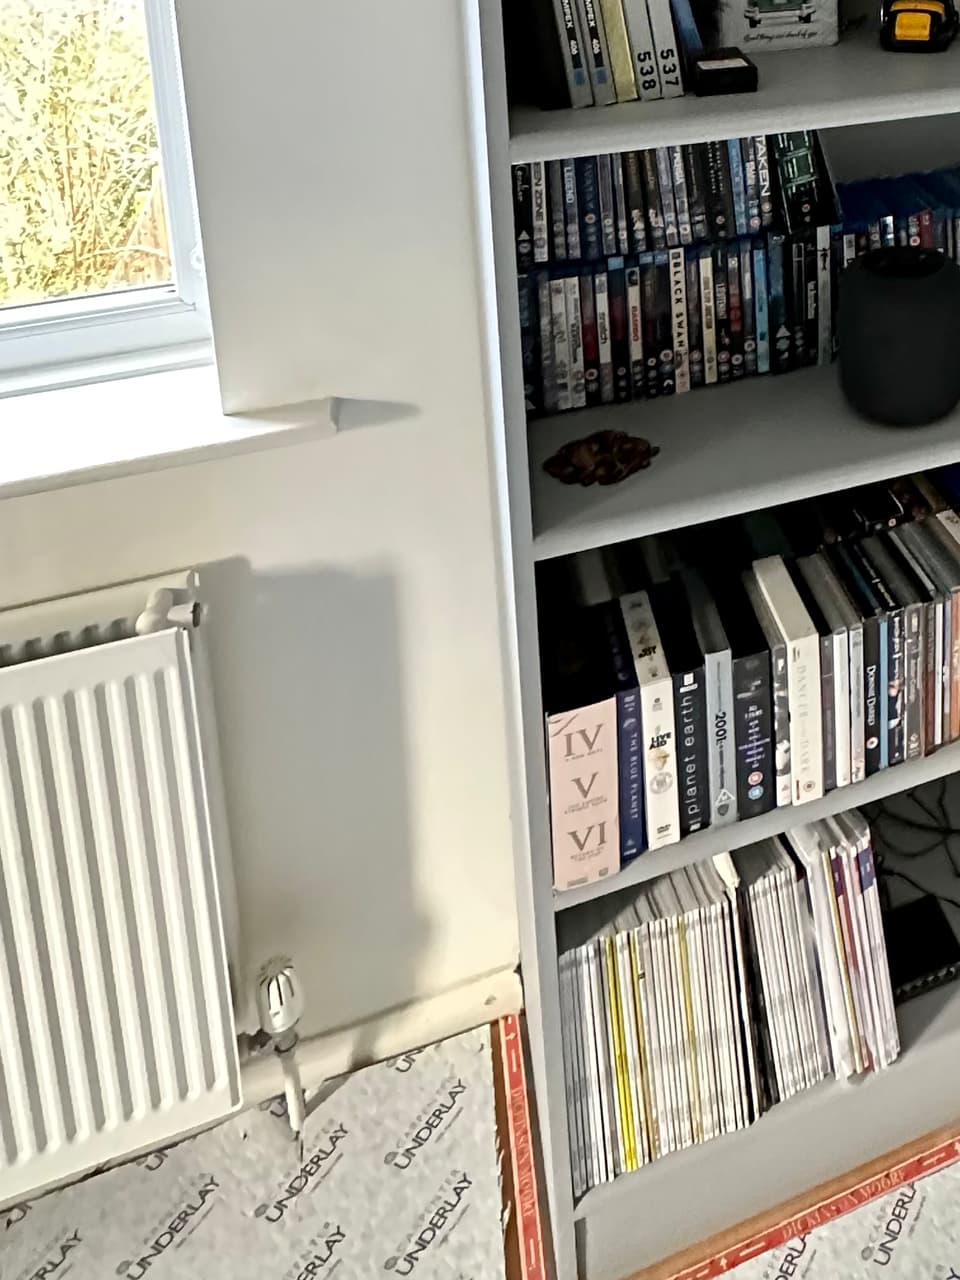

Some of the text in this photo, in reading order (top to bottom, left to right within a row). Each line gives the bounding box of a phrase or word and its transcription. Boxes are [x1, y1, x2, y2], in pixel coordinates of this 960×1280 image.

[637, 50, 656, 91] 538
[660, 48, 680, 88] 537
[755, 135, 771, 196] TAKEN
[673, 262, 684, 348] BLACK SWAN
[564, 723, 604, 758] IV
[681, 696, 700, 815] planet earth
[571, 771, 598, 799] V
[630, 784, 638, 819] PLANET
[568, 820, 608, 852] VI
[394, 1078, 467, 1170] UNDERLAY
[265, 1123, 348, 1222] UNDERLAY
[126, 1176, 220, 1280] UNDERLAY
[296, 1226, 346, 1280] ERLAY
[395, 1172, 472, 1276] UNDERLAY
[874, 1181, 917, 1266] UNDERLA
